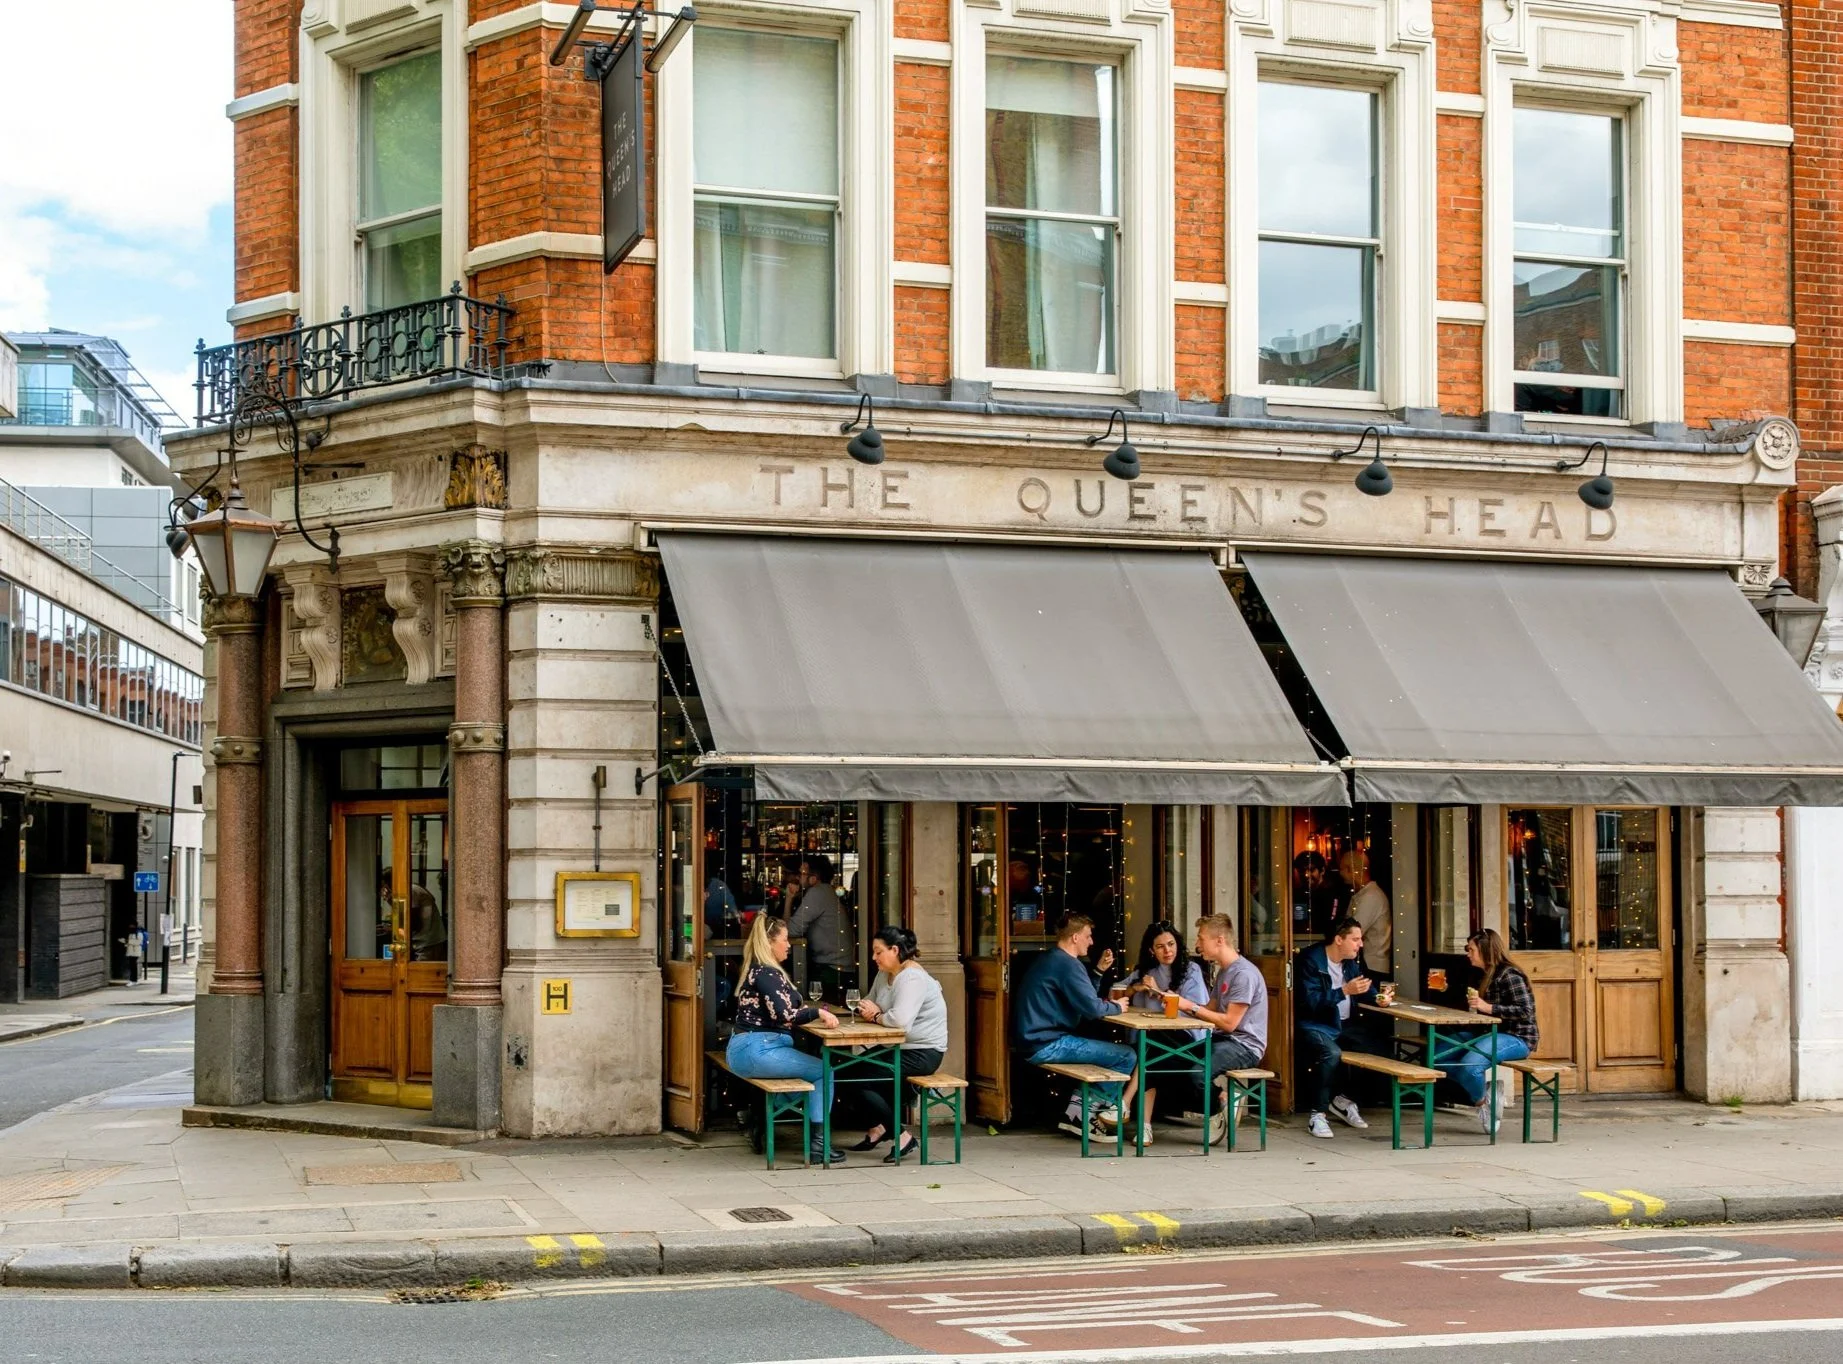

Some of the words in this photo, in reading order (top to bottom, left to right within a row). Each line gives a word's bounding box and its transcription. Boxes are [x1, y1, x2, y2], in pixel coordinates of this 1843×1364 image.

[613, 111, 627, 140] THE
[606, 129, 636, 180] QUEEN'S
[612, 164, 631, 199] HEAD
[759, 463, 911, 511] THE
[1016, 476, 1328, 528] QUEEN'S
[1424, 494, 1618, 542] HEAD
[547, 983, 567, 1010] H
[1401, 1246, 1843, 1302] BUS
[813, 1268, 1406, 1347] LANE
